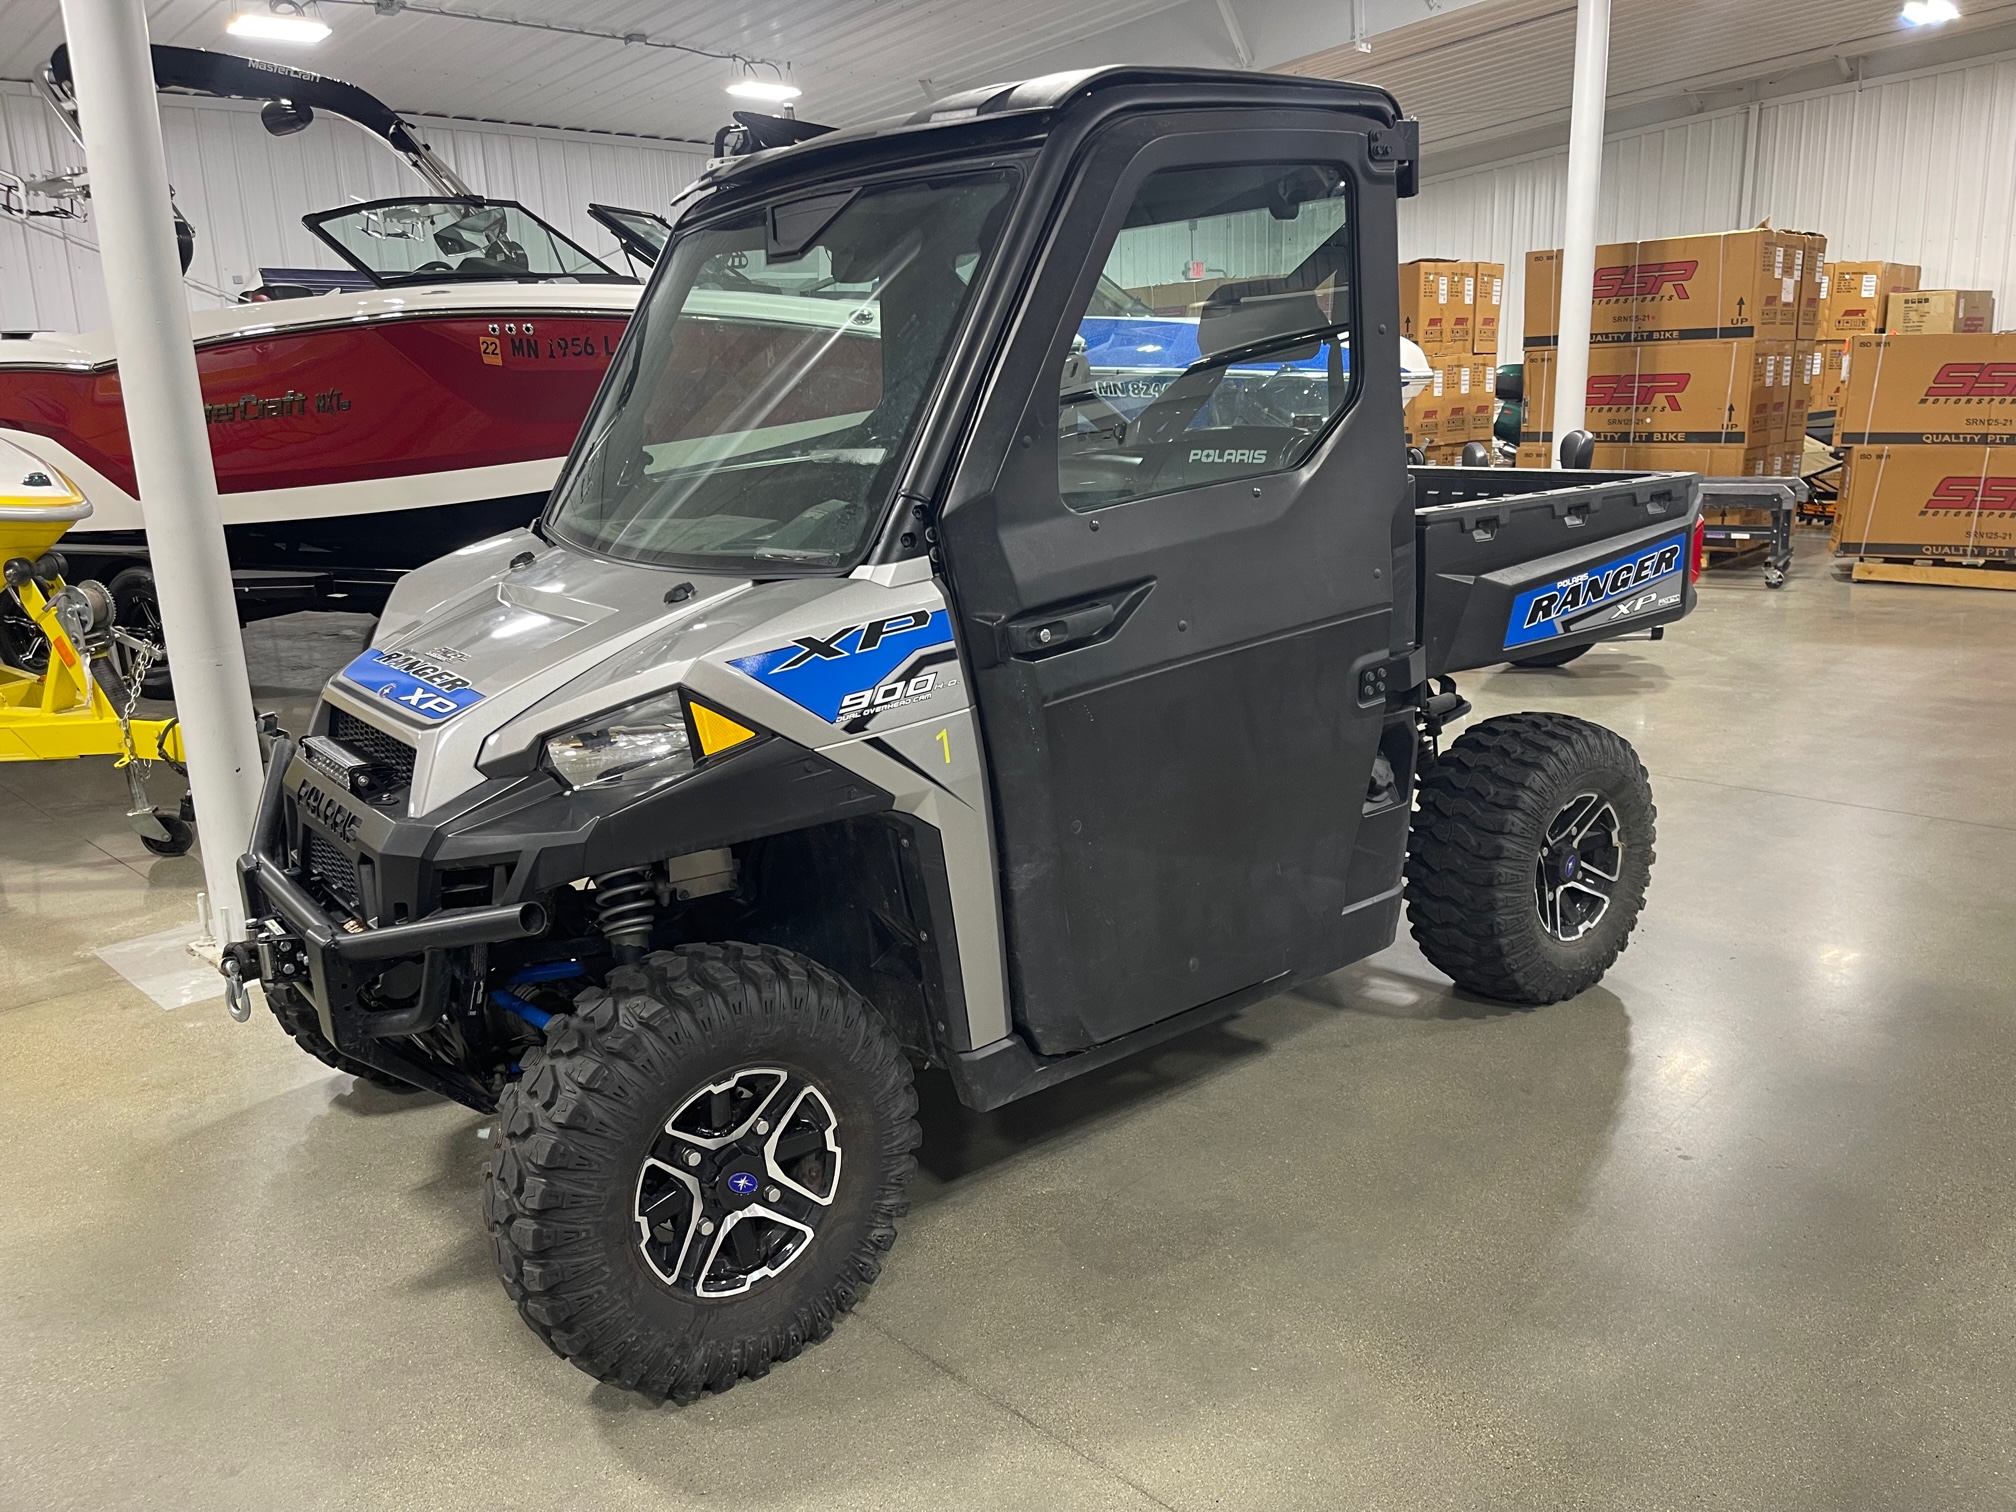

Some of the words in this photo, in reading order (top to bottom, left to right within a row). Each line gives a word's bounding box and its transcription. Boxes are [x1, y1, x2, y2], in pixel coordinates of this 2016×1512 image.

[1592, 260, 1699, 300] SSR
[1591, 295, 1675, 306] TORSPORTS
[1612, 314, 1651, 323] SRN15-21
[1730, 317, 1749, 326] UP
[481, 340, 499, 356] 22
[510, 337, 540, 359] MN
[548, 336, 596, 359] 1956
[603, 335, 620, 356] L
[1590, 333, 1627, 342] UALITY
[1632, 332, 1649, 340] PIT
[1652, 330, 1680, 339] BIKE
[1096, 380, 1127, 397] MN
[1923, 362, 2016, 397] SS
[1586, 373, 1691, 412] SSR
[1918, 397, 2016, 406] MOTORSPOR
[205, 389, 308, 425] terCraft
[1585, 406, 1667, 414] TORSPORTS
[1593, 432, 1621, 441] LITY
[1631, 432, 1649, 441] IT
[1653, 432, 1686, 441] BIKE
[1721, 423, 1739, 431] UP
[1922, 434, 1981, 444] QUALITY
[1987, 434, 2010, 443] PIT
[1188, 449, 1268, 464] POLARIS
[1923, 476, 2016, 511] SS
[1922, 545, 1980, 555] QUALITY
[1986, 547, 2009, 557] PIT
[1523, 544, 1681, 629] RANGER
[1557, 573, 1589, 590] POLARIS
[1609, 593, 1657, 621] XP
[768, 607, 932, 675] XP
[373, 651, 473, 694] RANGER
[398, 687, 458, 713] XP
[838, 671, 938, 715] 900
[835, 712, 862, 723] DUAL
[862, 698, 912, 716] OVERHEAD
[912, 692, 932, 703] CAM
[935, 727, 951, 764] 1
[298, 778, 364, 844] POLARIS
